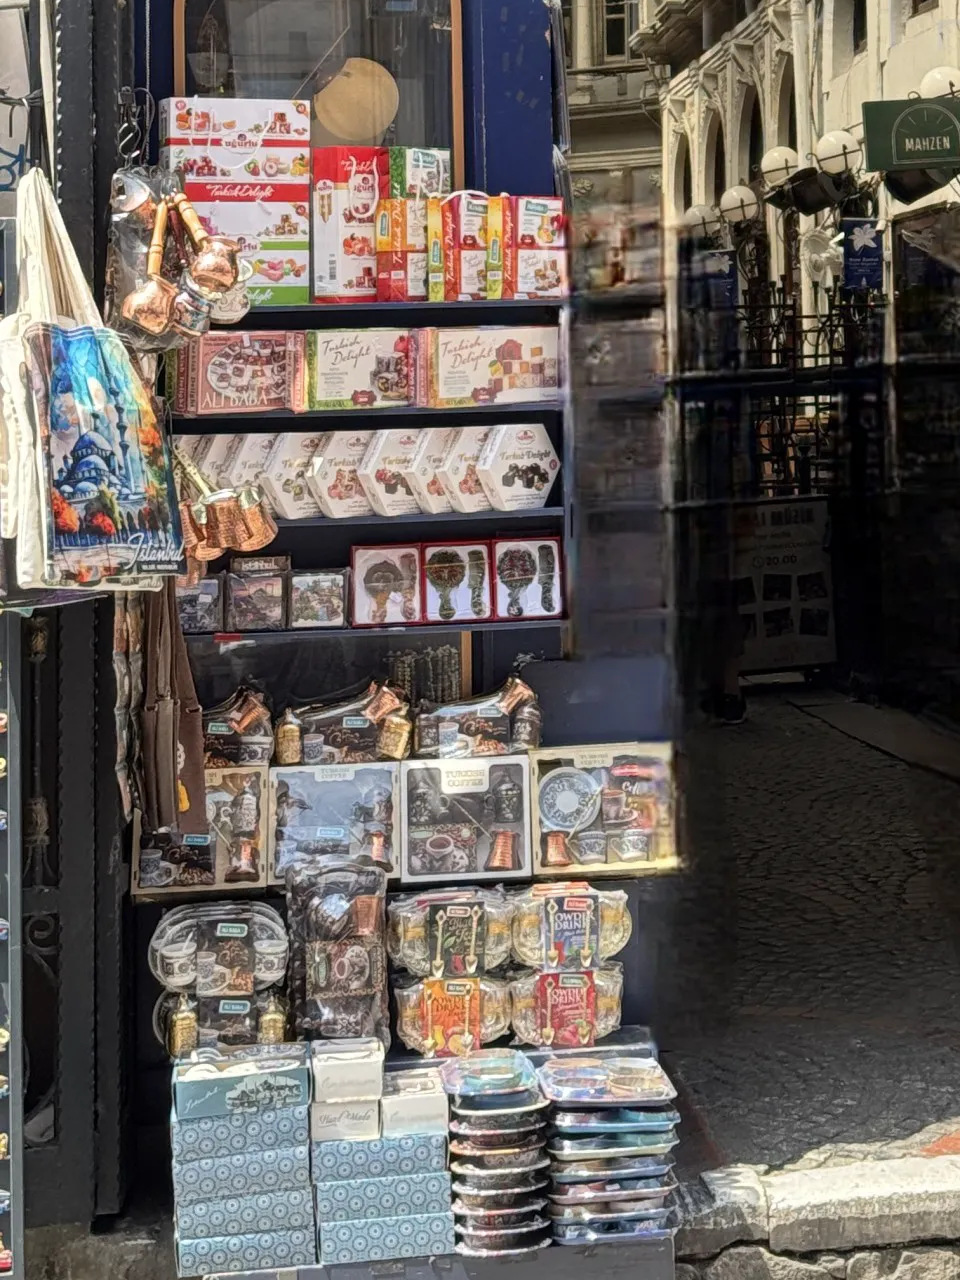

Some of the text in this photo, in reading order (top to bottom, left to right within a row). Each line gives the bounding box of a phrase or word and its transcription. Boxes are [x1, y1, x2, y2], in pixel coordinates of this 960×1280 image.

[905, 136, 951, 152] MAHZEN
[322, 334, 362, 355] Turkish
[441, 335, 482, 358] Turkish
[331, 345, 372, 368] Delight
[450, 346, 494, 371] Delight
